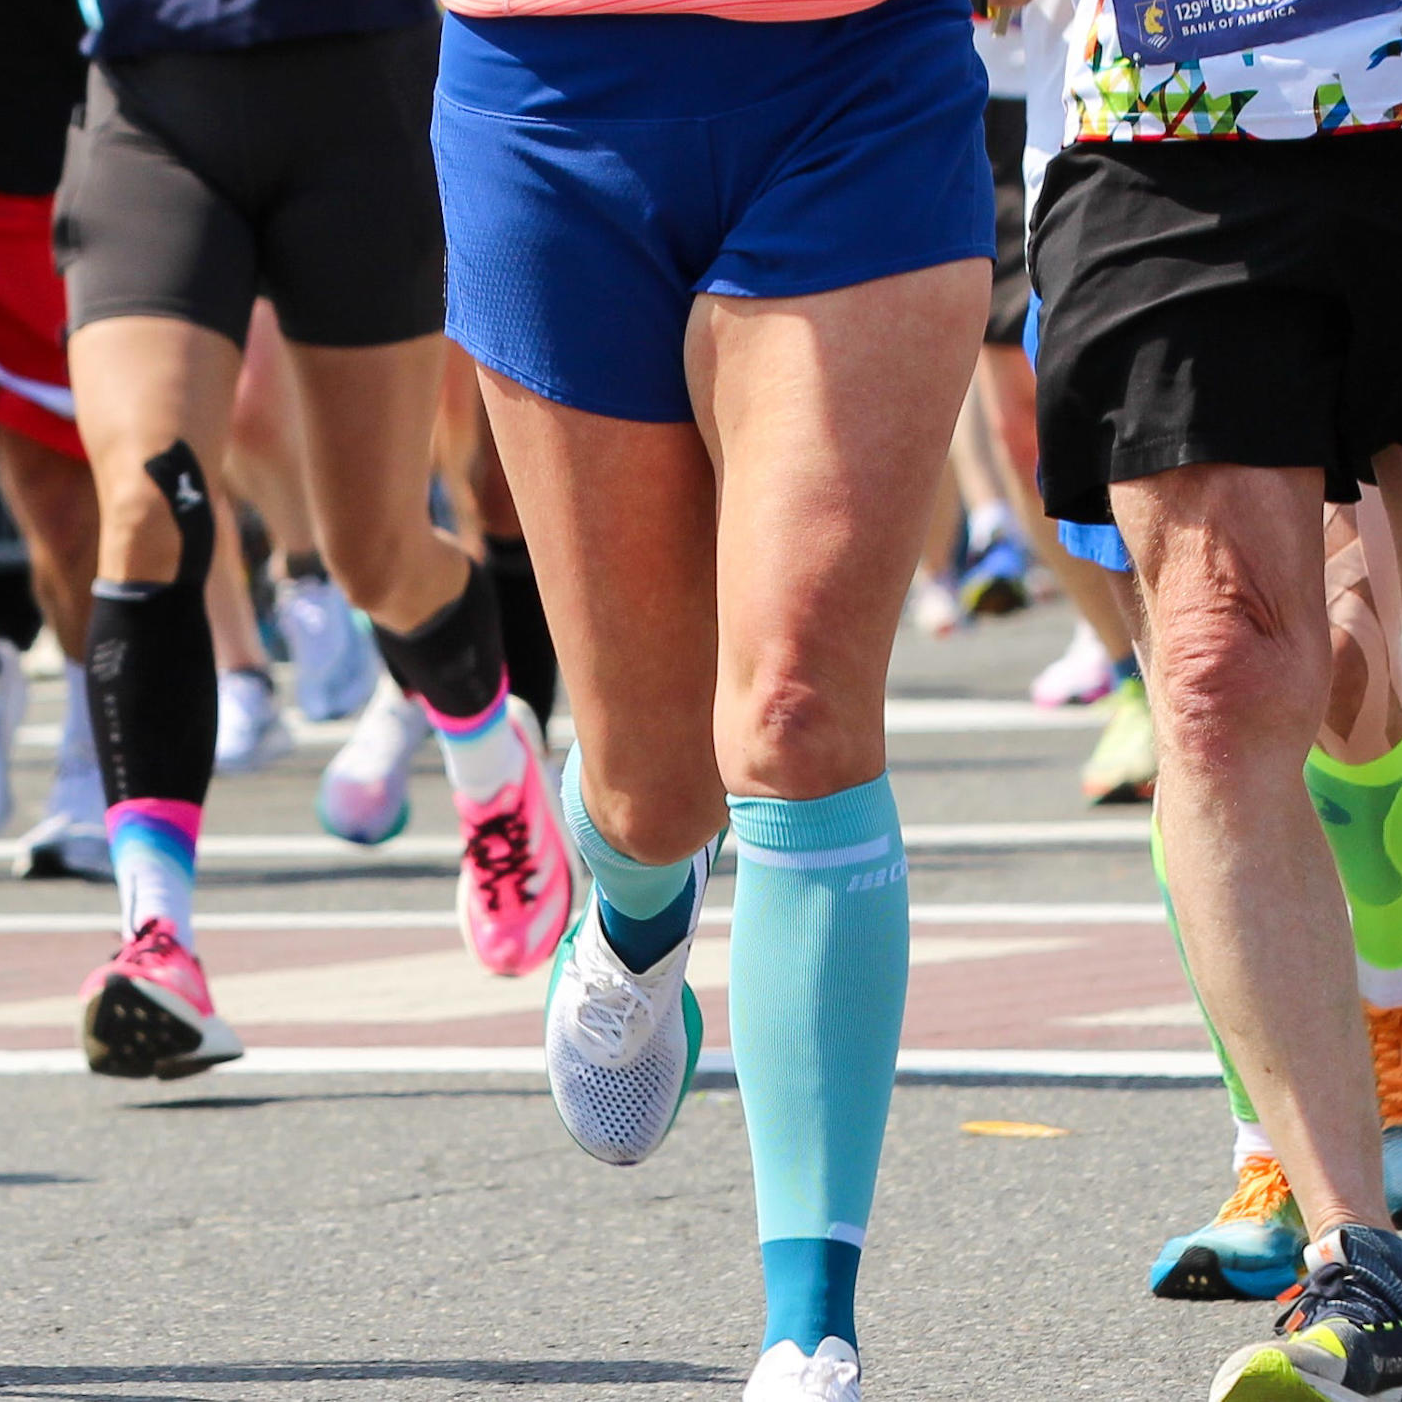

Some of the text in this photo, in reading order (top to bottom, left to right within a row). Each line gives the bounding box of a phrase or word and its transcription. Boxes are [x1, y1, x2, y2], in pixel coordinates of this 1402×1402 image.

[1174, 0, 1210, 22] 129TH
[1181, 6, 1297, 36] BANK OF AMERICA
